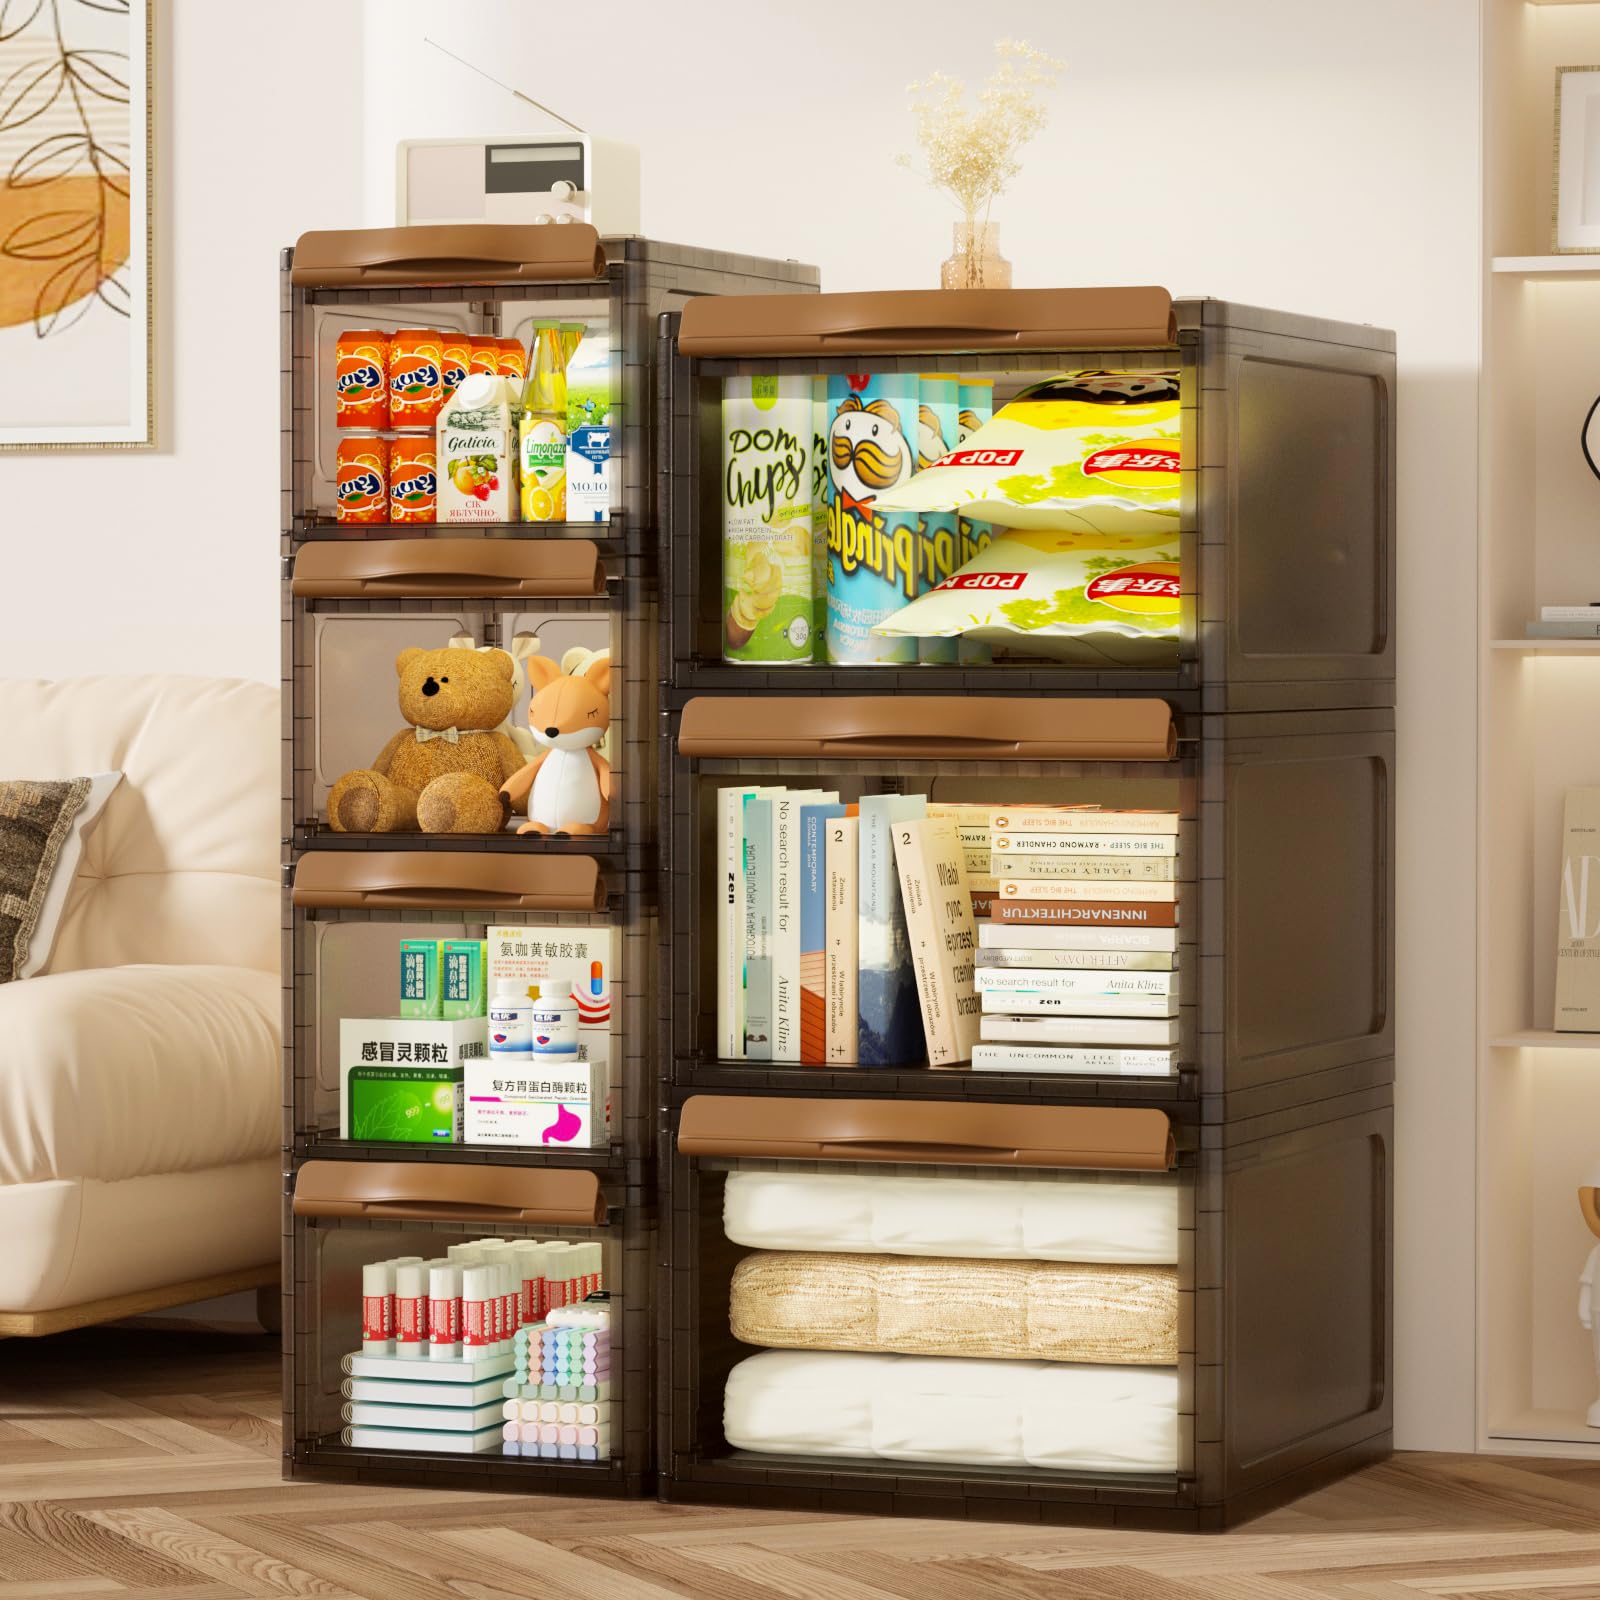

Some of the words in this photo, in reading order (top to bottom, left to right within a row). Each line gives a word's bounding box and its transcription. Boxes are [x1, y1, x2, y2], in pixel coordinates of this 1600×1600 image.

[448, 436, 496, 452] Galicia
[960, 451, 1016, 464] POP
[571, 482, 608, 491] МОЛО
[727, 448, 805, 523] Chips
[963, 575, 1019, 587] POP
[779, 801, 790, 819] No
[834, 830, 843, 842] 2
[901, 832, 911, 845] 2
[1016, 840, 1057, 848] CHANDLER
[779, 824, 790, 868] search
[1110, 841, 1131, 849] SLEEP
[1082, 867, 1132, 875] HARRY
[779, 873, 790, 910] result
[838, 877, 846, 905] Zmiana
[906, 874, 917, 914] ustawienia
[914, 879, 923, 906] Zmiana
[1002, 907, 1147, 920] INNENARCHITEKTUR
[779, 915, 790, 933] for
[500, 941, 588, 958] 氨咖黄敏胶囊
[1054, 954, 1086, 966] DAYS
[1089, 955, 1128, 966] AFTER
[830, 954, 838, 995] przestrzeni
[980, 977, 993, 985] No
[996, 977, 1029, 986] search
[1032, 978, 1059, 987] result
[1061, 978, 1075, 987] for
[1106, 979, 1135, 989] Anita
[1137, 979, 1165, 990] Klinz
[779, 976, 790, 1012] Anita
[837, 980, 846, 1017] labiryncie
[779, 1017, 790, 1053] Klinz
[361, 1041, 448, 1063] 感冒灵颗粒
[492, 1080, 588, 1094] 复方胃蛋白酶颗粒
